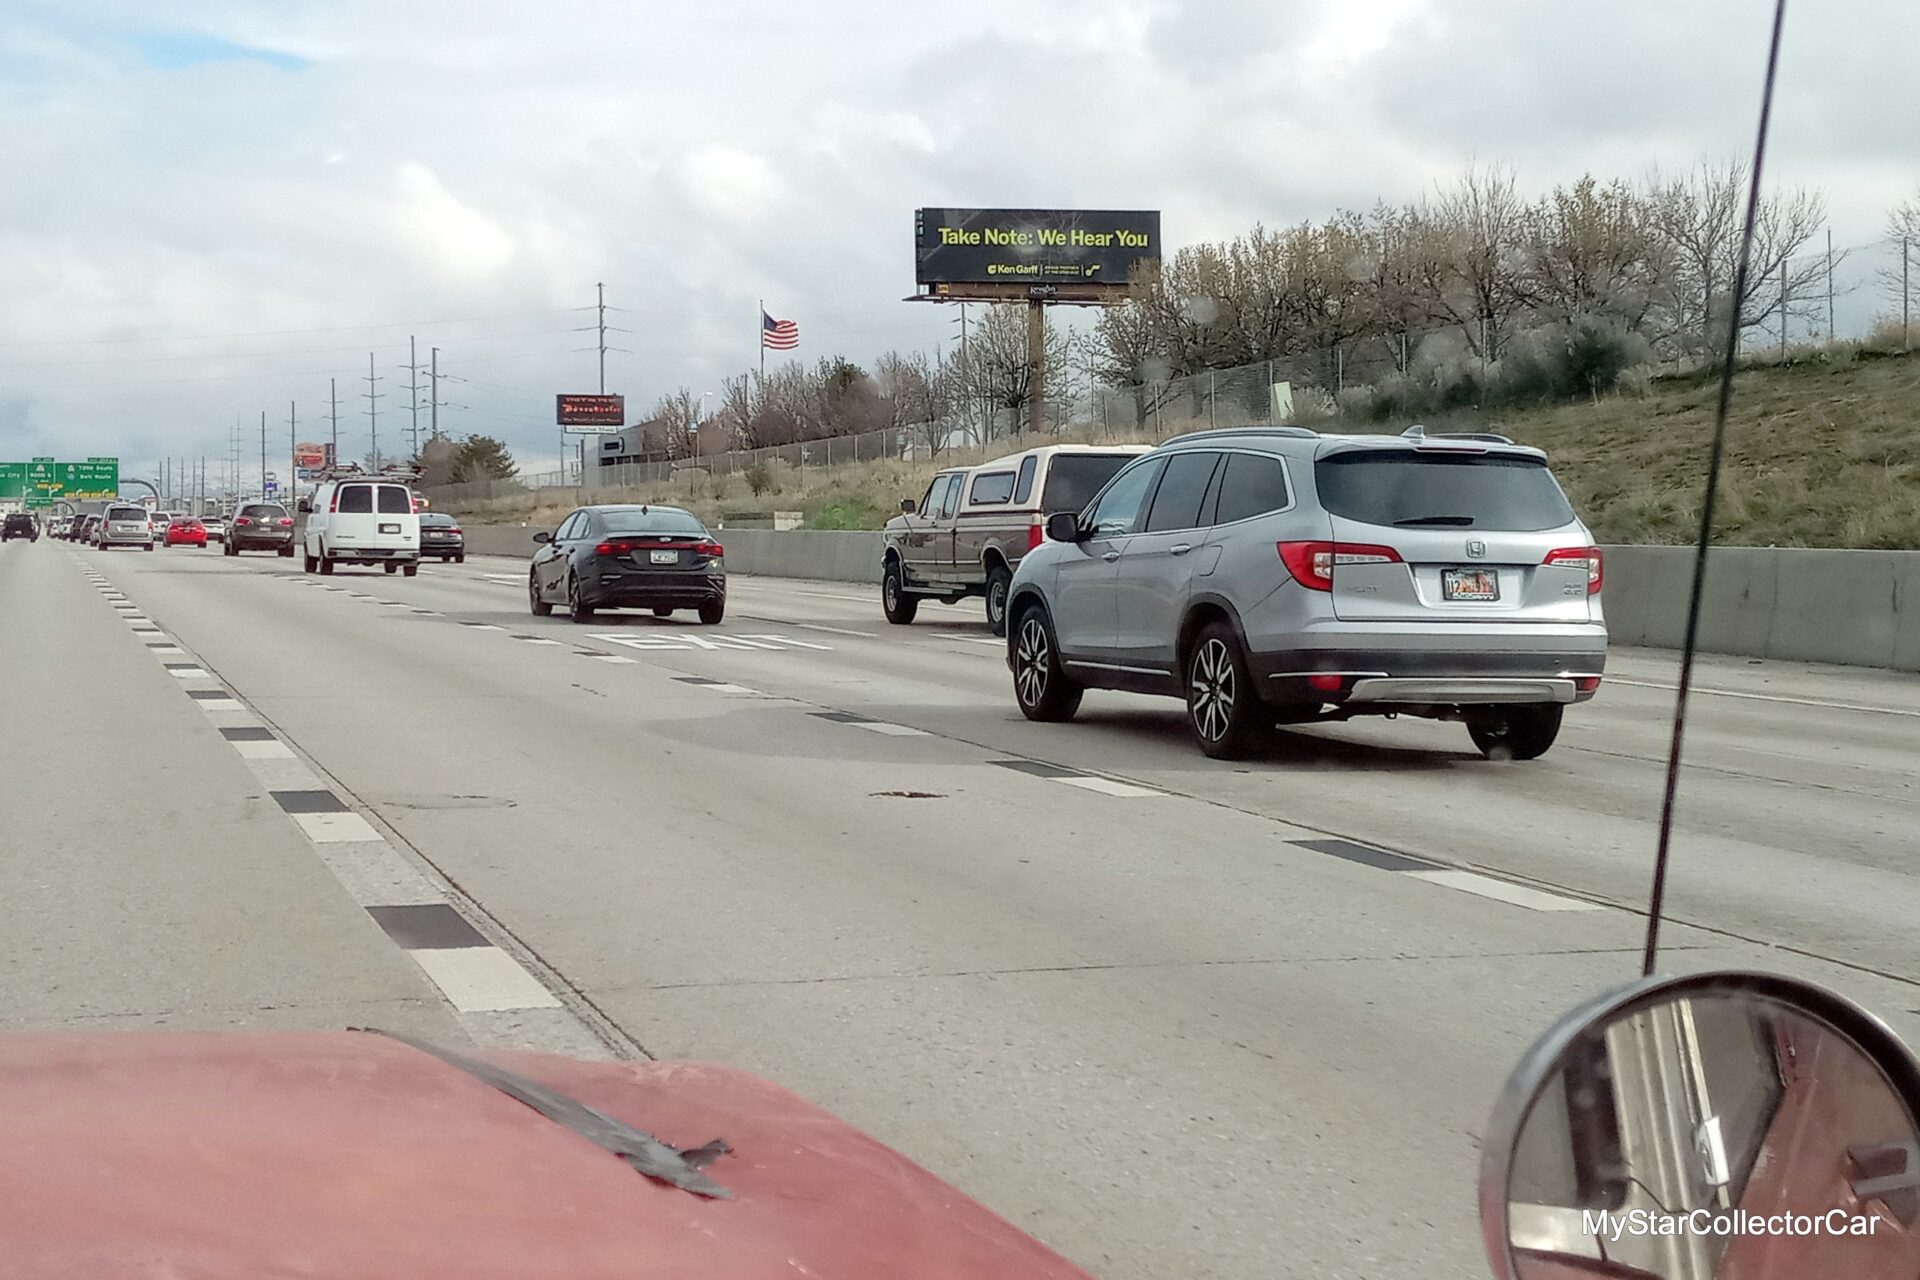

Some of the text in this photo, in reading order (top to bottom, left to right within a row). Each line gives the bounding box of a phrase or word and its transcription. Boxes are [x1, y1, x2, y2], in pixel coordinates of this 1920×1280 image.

[938, 228, 1149, 247] Take Note: We Hear You
[998, 264, 1015, 274] Ken
[1016, 264, 1038, 274] Garff
